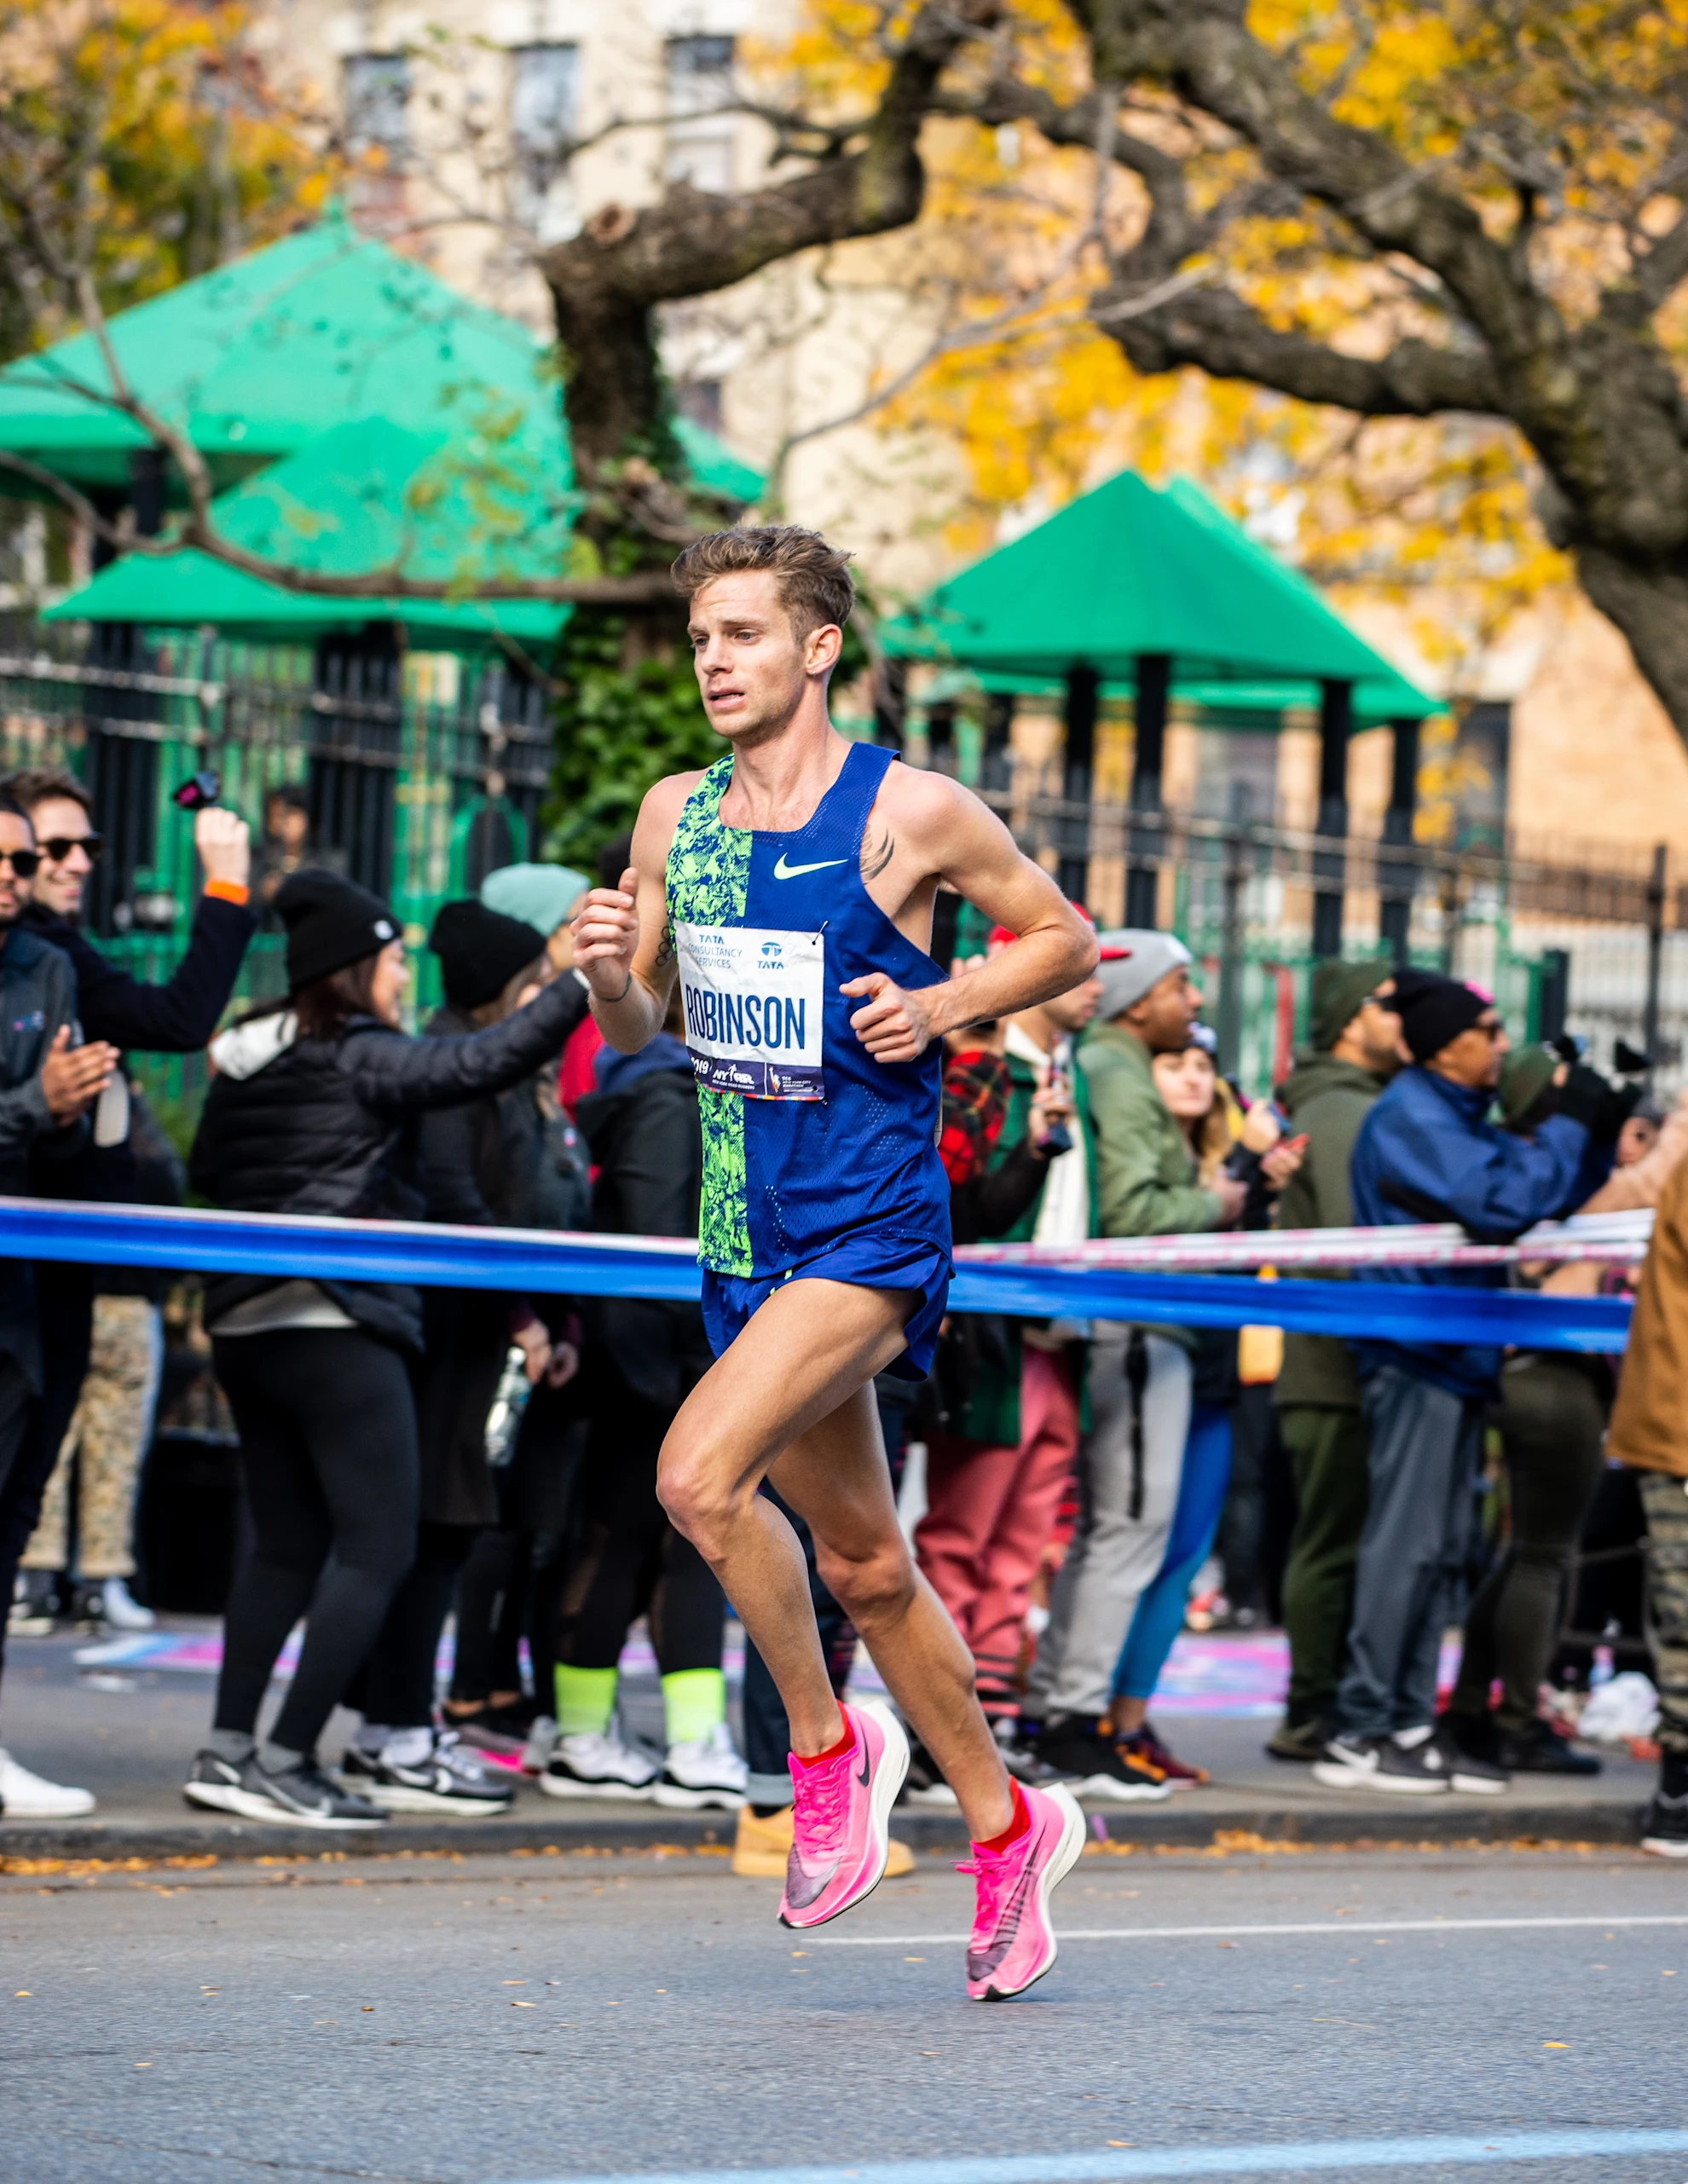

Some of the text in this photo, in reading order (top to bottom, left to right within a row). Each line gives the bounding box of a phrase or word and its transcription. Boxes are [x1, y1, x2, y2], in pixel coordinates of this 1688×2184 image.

[699, 934, 724, 945] TATA
[689, 943, 743, 957] CONSULTANCY
[695, 956, 731, 968] SERVICES
[757, 960, 783, 969] TATA
[685, 984, 805, 1049] ROBINSON
